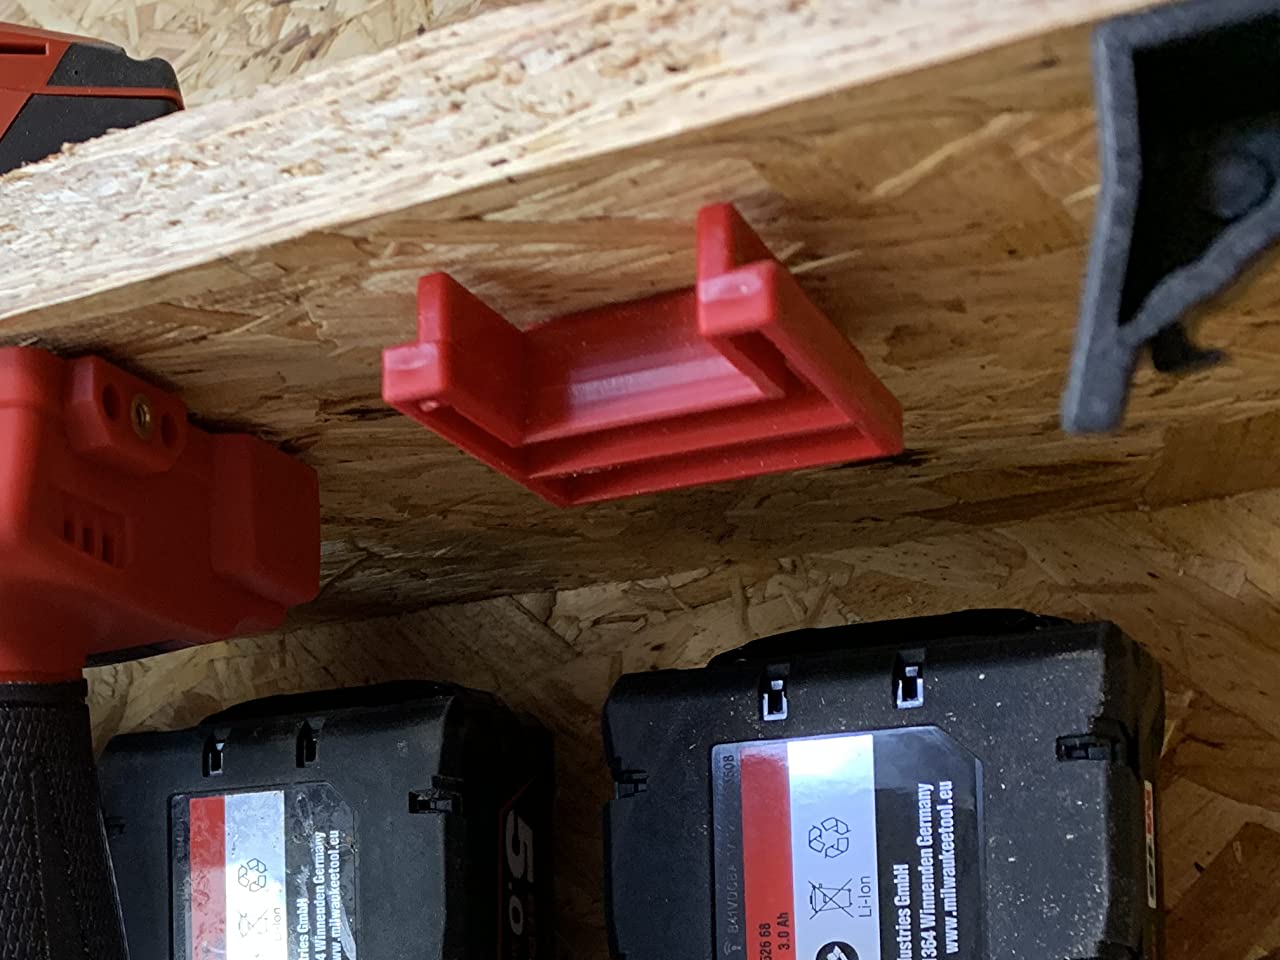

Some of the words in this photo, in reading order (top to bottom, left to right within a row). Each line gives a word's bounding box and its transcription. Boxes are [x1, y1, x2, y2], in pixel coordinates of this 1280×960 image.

[916, 784, 935, 845] Germany
[314, 831, 327, 883] Germany
[938, 781, 959, 953] www.milwaukeetool.eu
[857, 876, 871, 917] Li-Ion
[894, 864, 911, 905] GmbH
[919, 849, 936, 927] Winnenden
[297, 898, 308, 932] GmbH
[315, 884, 326, 951] Winnenden
[758, 923, 772, 938] 68
[776, 912, 789, 927] Ah
[777, 930, 790, 950] 3.0
